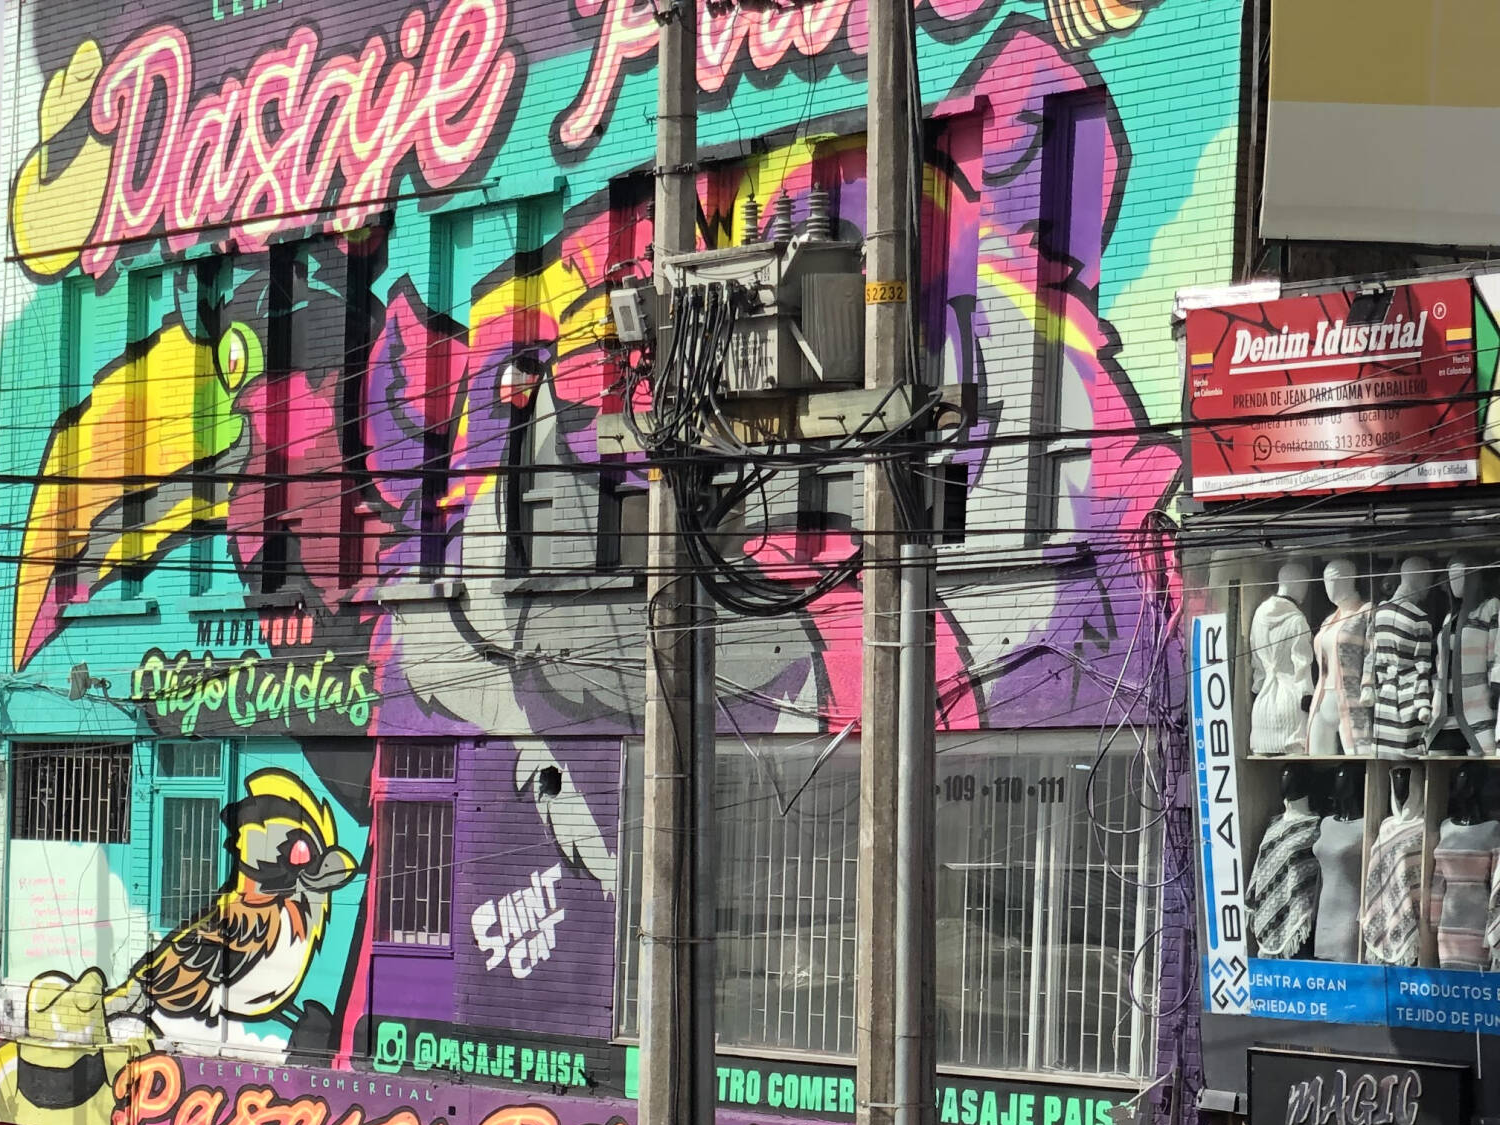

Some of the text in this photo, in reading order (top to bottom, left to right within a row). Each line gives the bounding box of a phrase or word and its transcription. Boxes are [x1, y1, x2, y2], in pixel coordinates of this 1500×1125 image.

[1231, 325, 1311, 365] Denim
[1312, 310, 1428, 358] Idustrial
[1233, 378, 1428, 409] PRENDA DE JEAN PARA DAMA Y CABALLERO
[1335, 435, 1352, 449] 313
[1355, 433, 1373, 447] 283
[944, 774, 975, 801] 109
[1038, 776, 1064, 803] 111
[1205, 625, 1242, 942] BLANBOR
[471, 862, 562, 972] SAINT
[1306, 977, 1347, 991] GRAN
[1399, 981, 1492, 1001] PRODUCTOS
[1250, 999, 1327, 1016] ARIEDAD DE
[1396, 1006, 1500, 1027] TEJIDO DE PUN
[199, 1061, 434, 1102] CENTRO COMERCIAL
[716, 1067, 761, 1105] TRO
[769, 1073, 855, 1114] COMER
